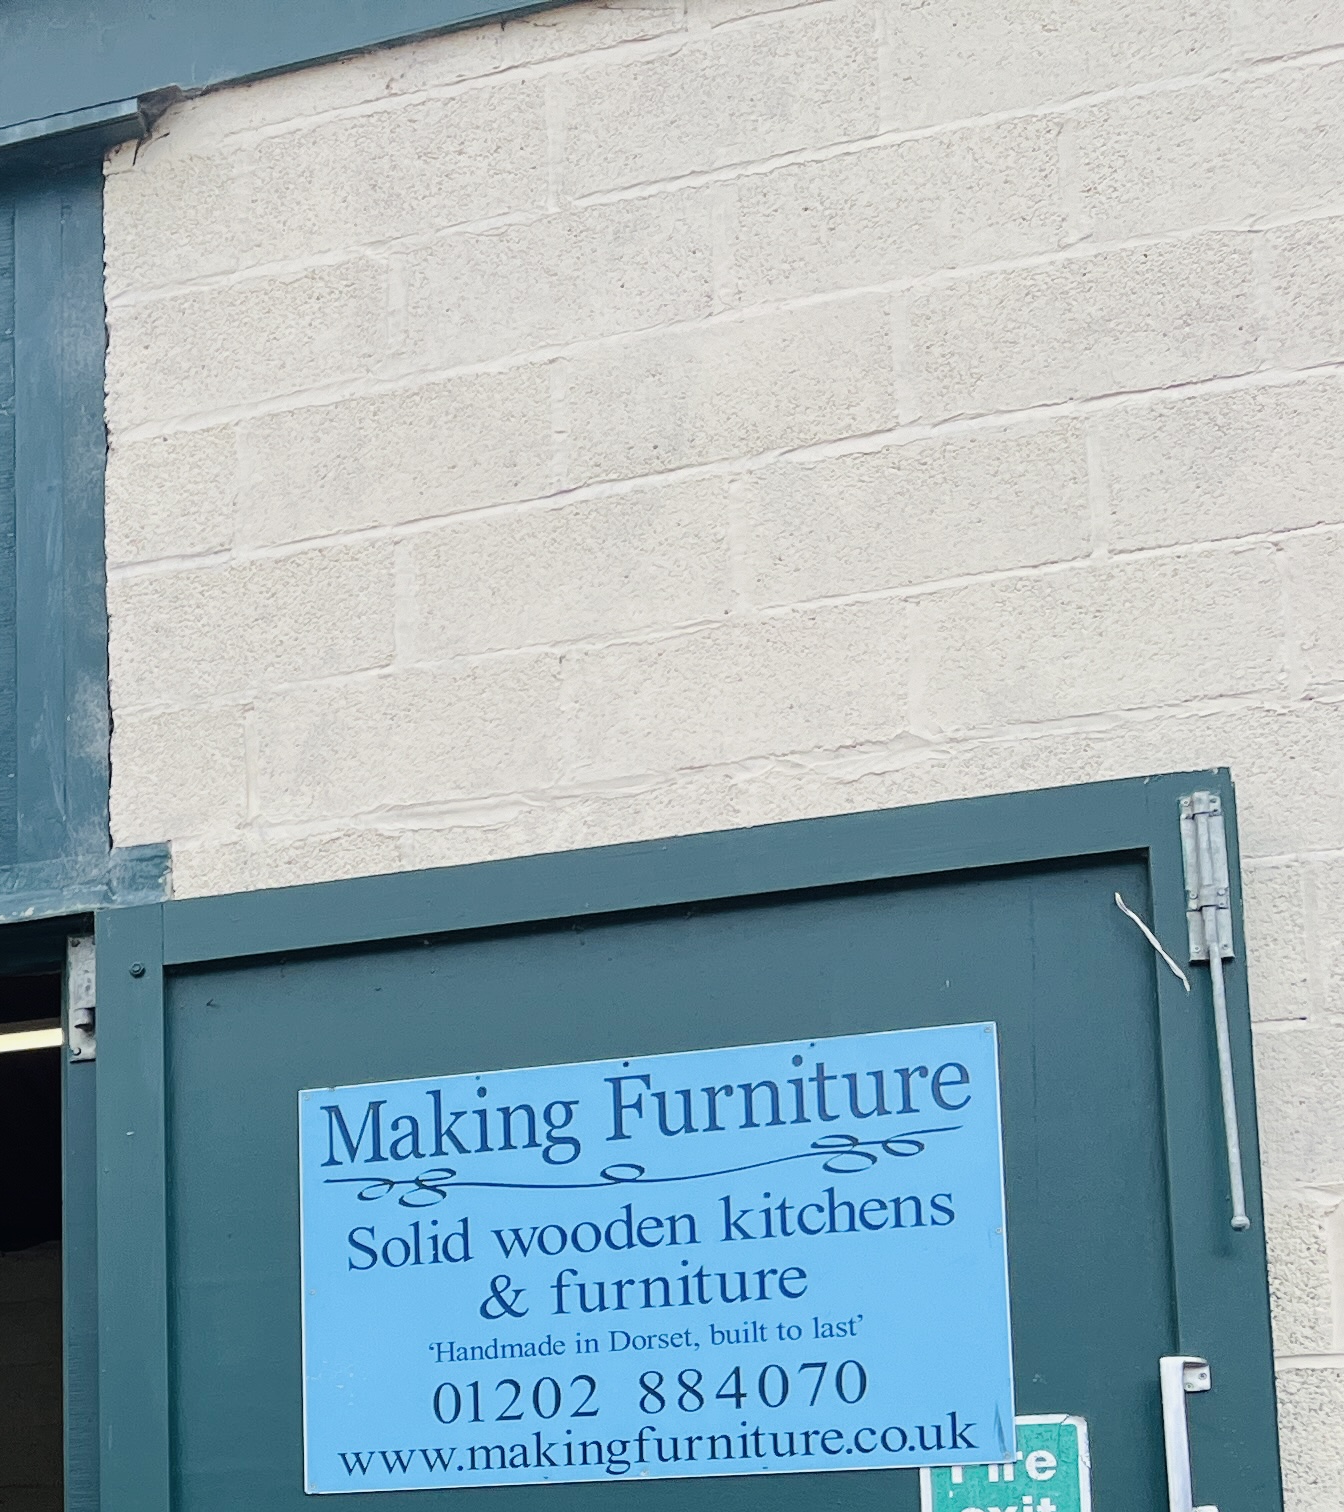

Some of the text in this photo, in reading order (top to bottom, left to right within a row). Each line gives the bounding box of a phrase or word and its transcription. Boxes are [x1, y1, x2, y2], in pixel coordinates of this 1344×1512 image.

[320, 1056, 972, 1166] Making Furniture
[348, 1187, 955, 1271] Solid wooden kitchens
[479, 1260, 808, 1320] & furniture
[575, 1333, 600, 1354] in
[608, 1328, 700, 1353] Dorset,
[709, 1321, 768, 1346] built
[776, 1320, 803, 1342] to
[433, 1359, 867, 1425] 01202 884070
[338, 1412, 979, 1476] www.makingfurniture.co.uk
